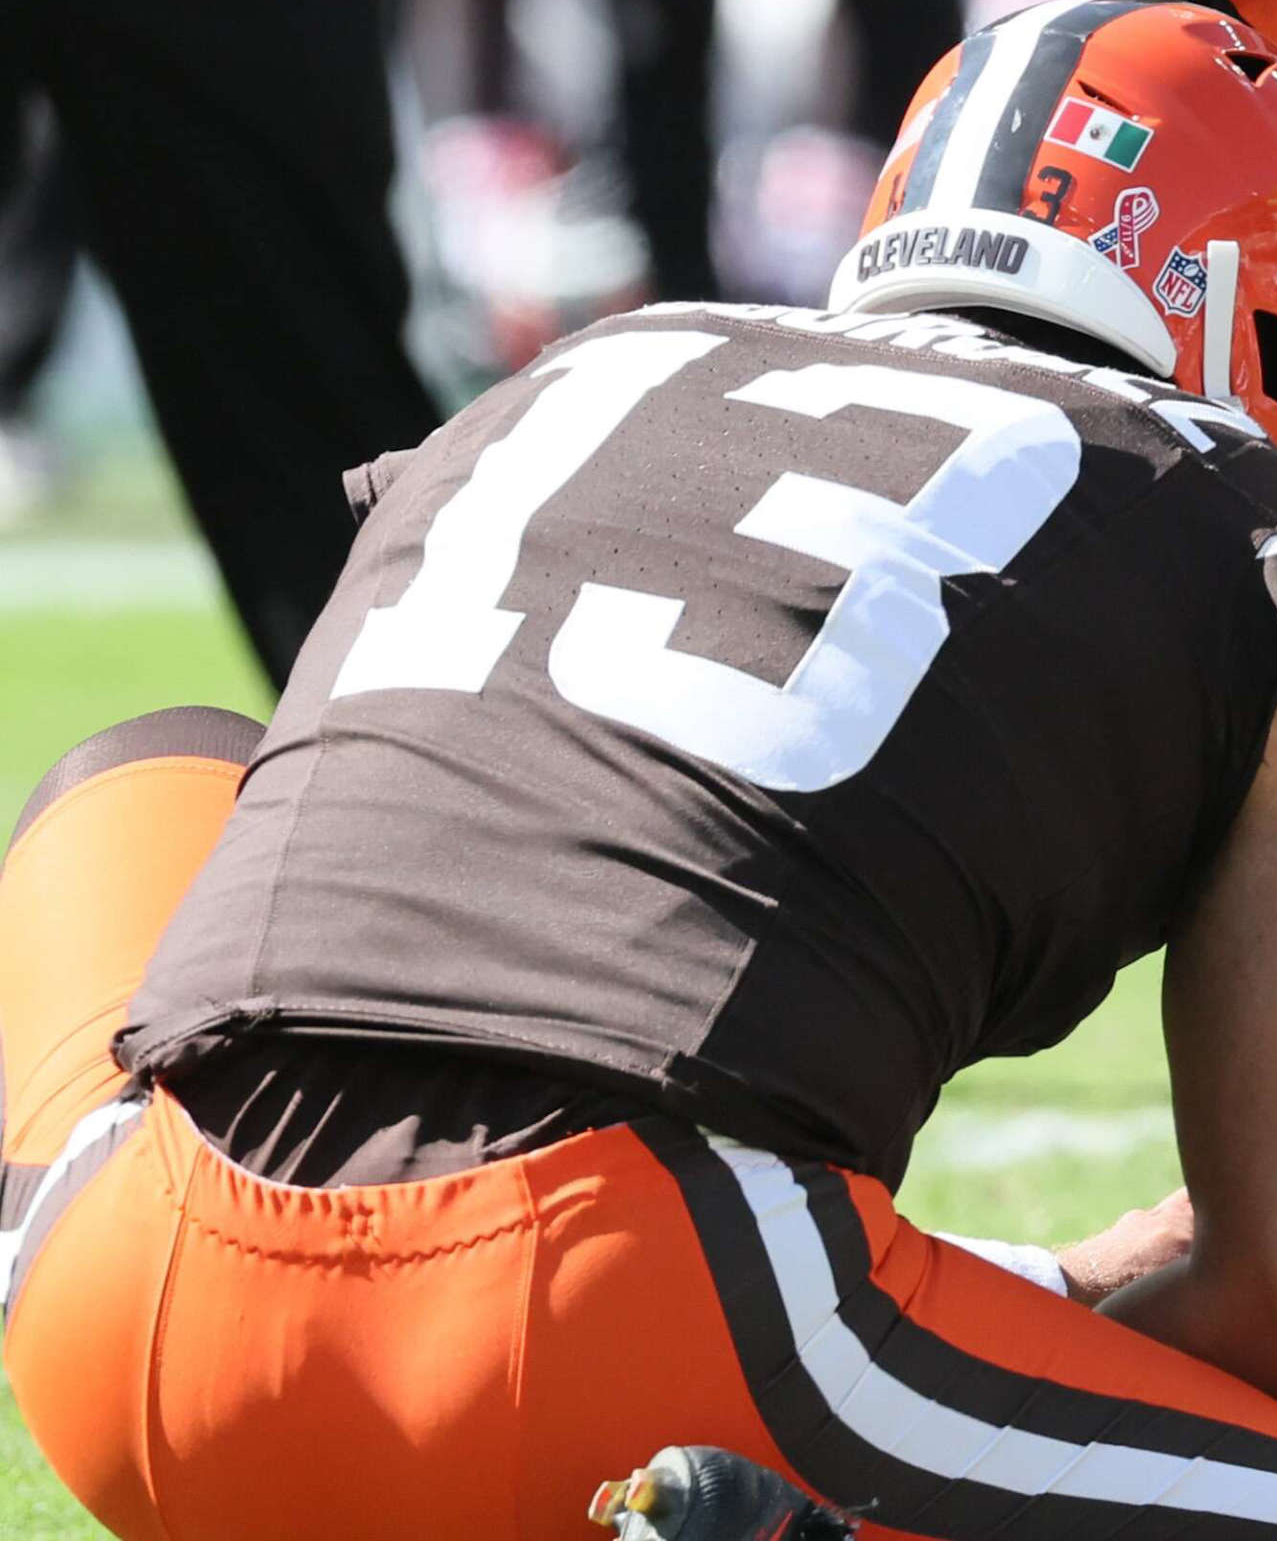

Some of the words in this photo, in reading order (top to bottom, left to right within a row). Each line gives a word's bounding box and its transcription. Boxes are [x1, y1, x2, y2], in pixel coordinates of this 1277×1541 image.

[1021, 166, 1073, 227] 3
[857, 227, 1030, 283] CLEVELAND
[1160, 270, 1197, 310] NFL
[329, 330, 1082, 792] 13
